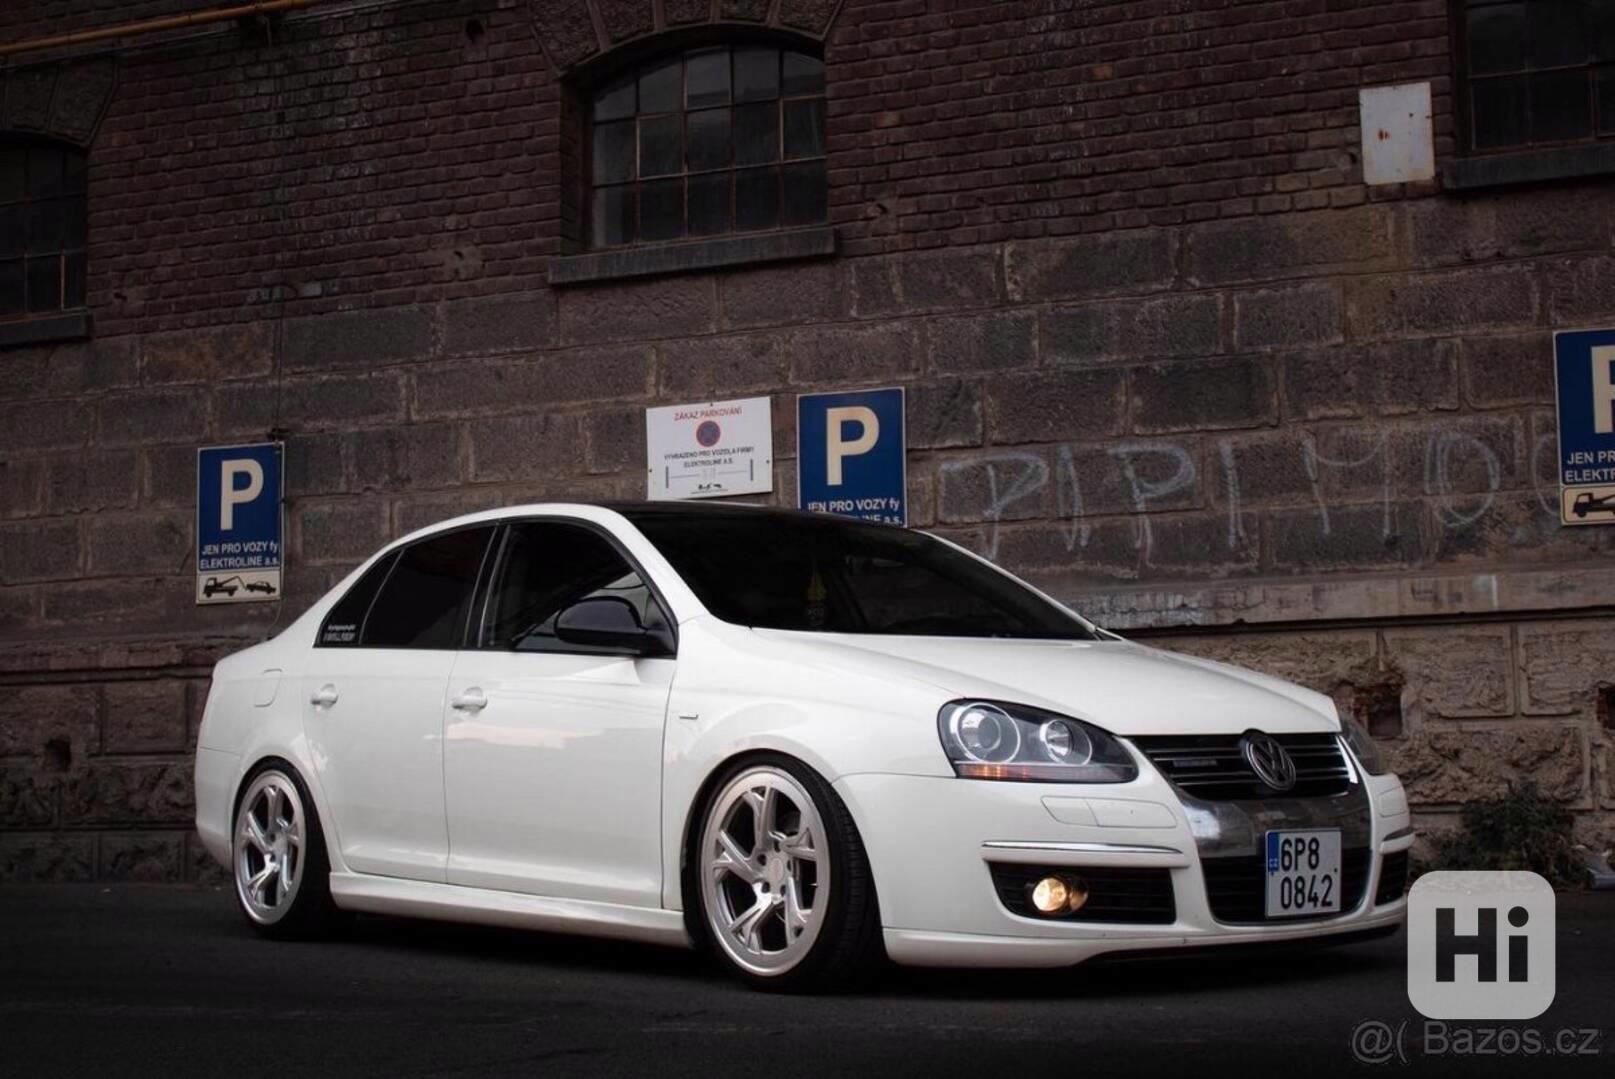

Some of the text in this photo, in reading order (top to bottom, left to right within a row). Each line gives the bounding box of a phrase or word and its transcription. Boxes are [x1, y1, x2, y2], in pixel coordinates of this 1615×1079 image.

[826, 406, 880, 486] P
[1567, 450, 1595, 465] JEN
[219, 458, 264, 531] P
[829, 499, 854, 512] PRO
[855, 498, 887, 511] VOZY
[201, 544, 219, 555] JEN
[221, 542, 241, 554] PRO
[242, 541, 268, 553] VOZY
[200, 556, 263, 569] ELEKTROLINE
[1281, 837, 1320, 872] 6P8
[1281, 874, 1333, 910] 0842
